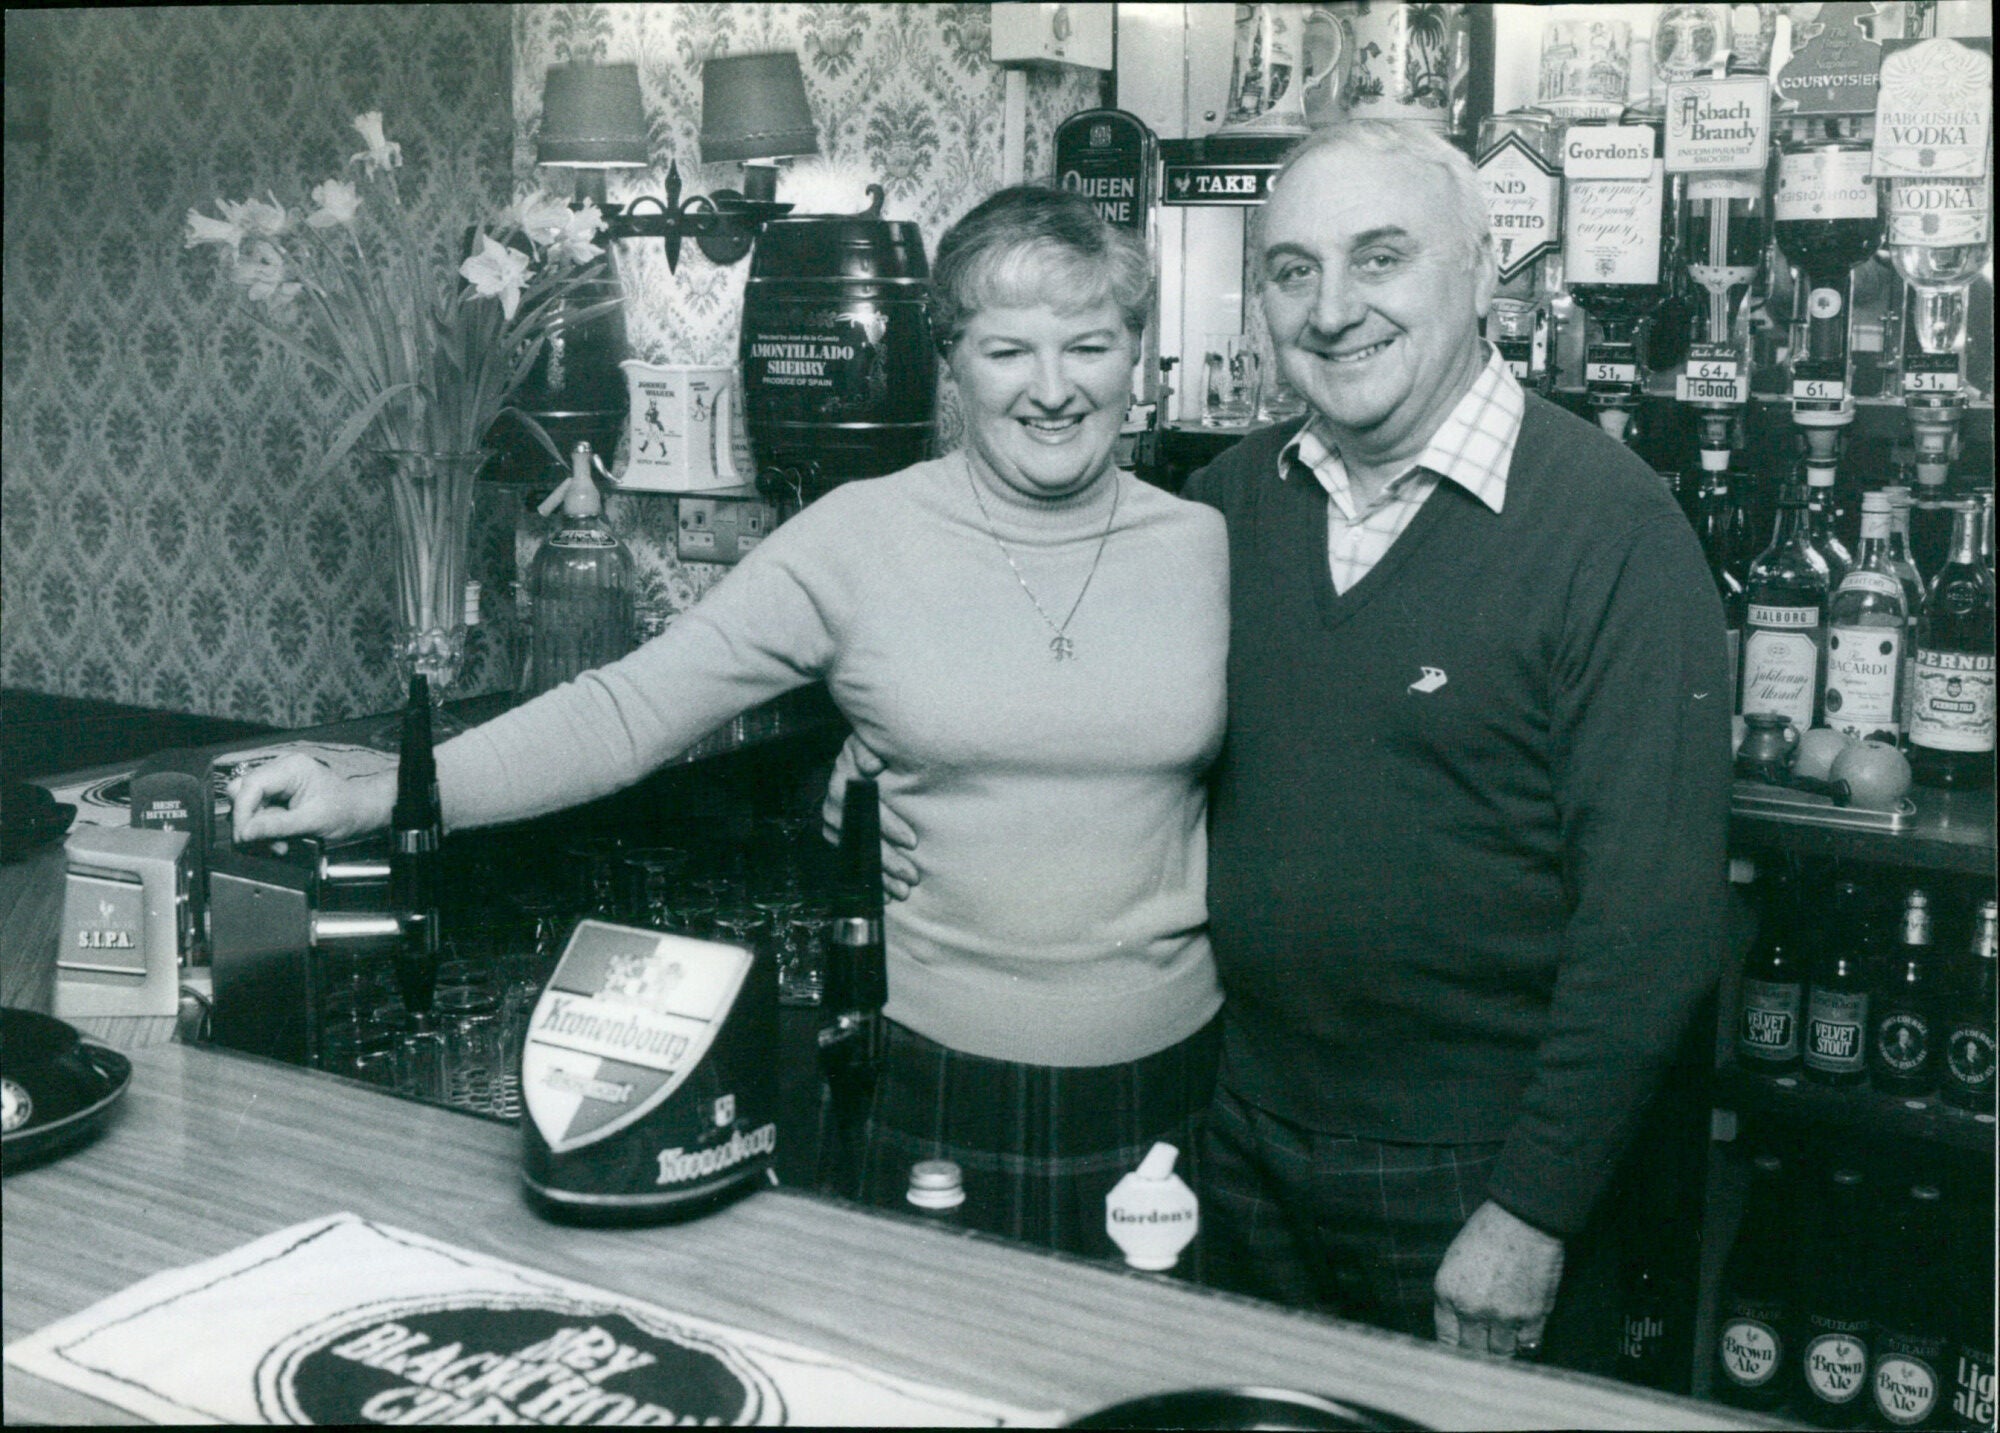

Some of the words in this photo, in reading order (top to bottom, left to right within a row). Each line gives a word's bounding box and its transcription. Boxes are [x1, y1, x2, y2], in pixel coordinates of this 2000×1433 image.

[1682, 96, 1751, 127] Asbach
[1882, 111, 1982, 126] BABOUSHKA
[1691, 121, 1760, 147] Brandy
[1891, 126, 1968, 146] VODKA
[1569, 142, 1650, 160] Gordon's
[1062, 170, 1135, 199] QUEEN
[1196, 174, 1257, 193] TAKE
[1493, 180, 1527, 195] GIN
[1897, 188, 1977, 210] VODKA
[750, 343, 855, 361] AMONTILLADO
[767, 360, 827, 377] SHERRY
[796, 377, 807, 387] OF
[808, 378, 833, 388] SPAIN
[1685, 377, 1738, 401] Asbach
[1756, 610, 1808, 623] AALBORG
[1829, 659, 1888, 676] BACARDI
[146, 809, 188, 820] BITTER
[152, 800, 182, 810] BEST
[1748, 1010, 1787, 1030] VELVET
[540, 999, 691, 1064] Kronenbourg
[1815, 1022, 1856, 1042] VELVET
[1816, 1038, 1853, 1057] STOUT
[1111, 1207, 1193, 1225] Gordon's
[1624, 1315, 1664, 1342] ight
[1622, 1336, 1643, 1358] le
[1724, 1336, 1773, 1361] Brown
[331, 1322, 723, 1426] BLACKTHOR
[1733, 1357, 1760, 1375] Ale
[1812, 1353, 1863, 1375] Brown
[1823, 1373, 1852, 1390] Ale
[1878, 1371, 1929, 1399] Brown
[1958, 1356, 1995, 1403] Lig
[1886, 1392, 1916, 1412] Ale
[1952, 1389, 1993, 1424] ale
